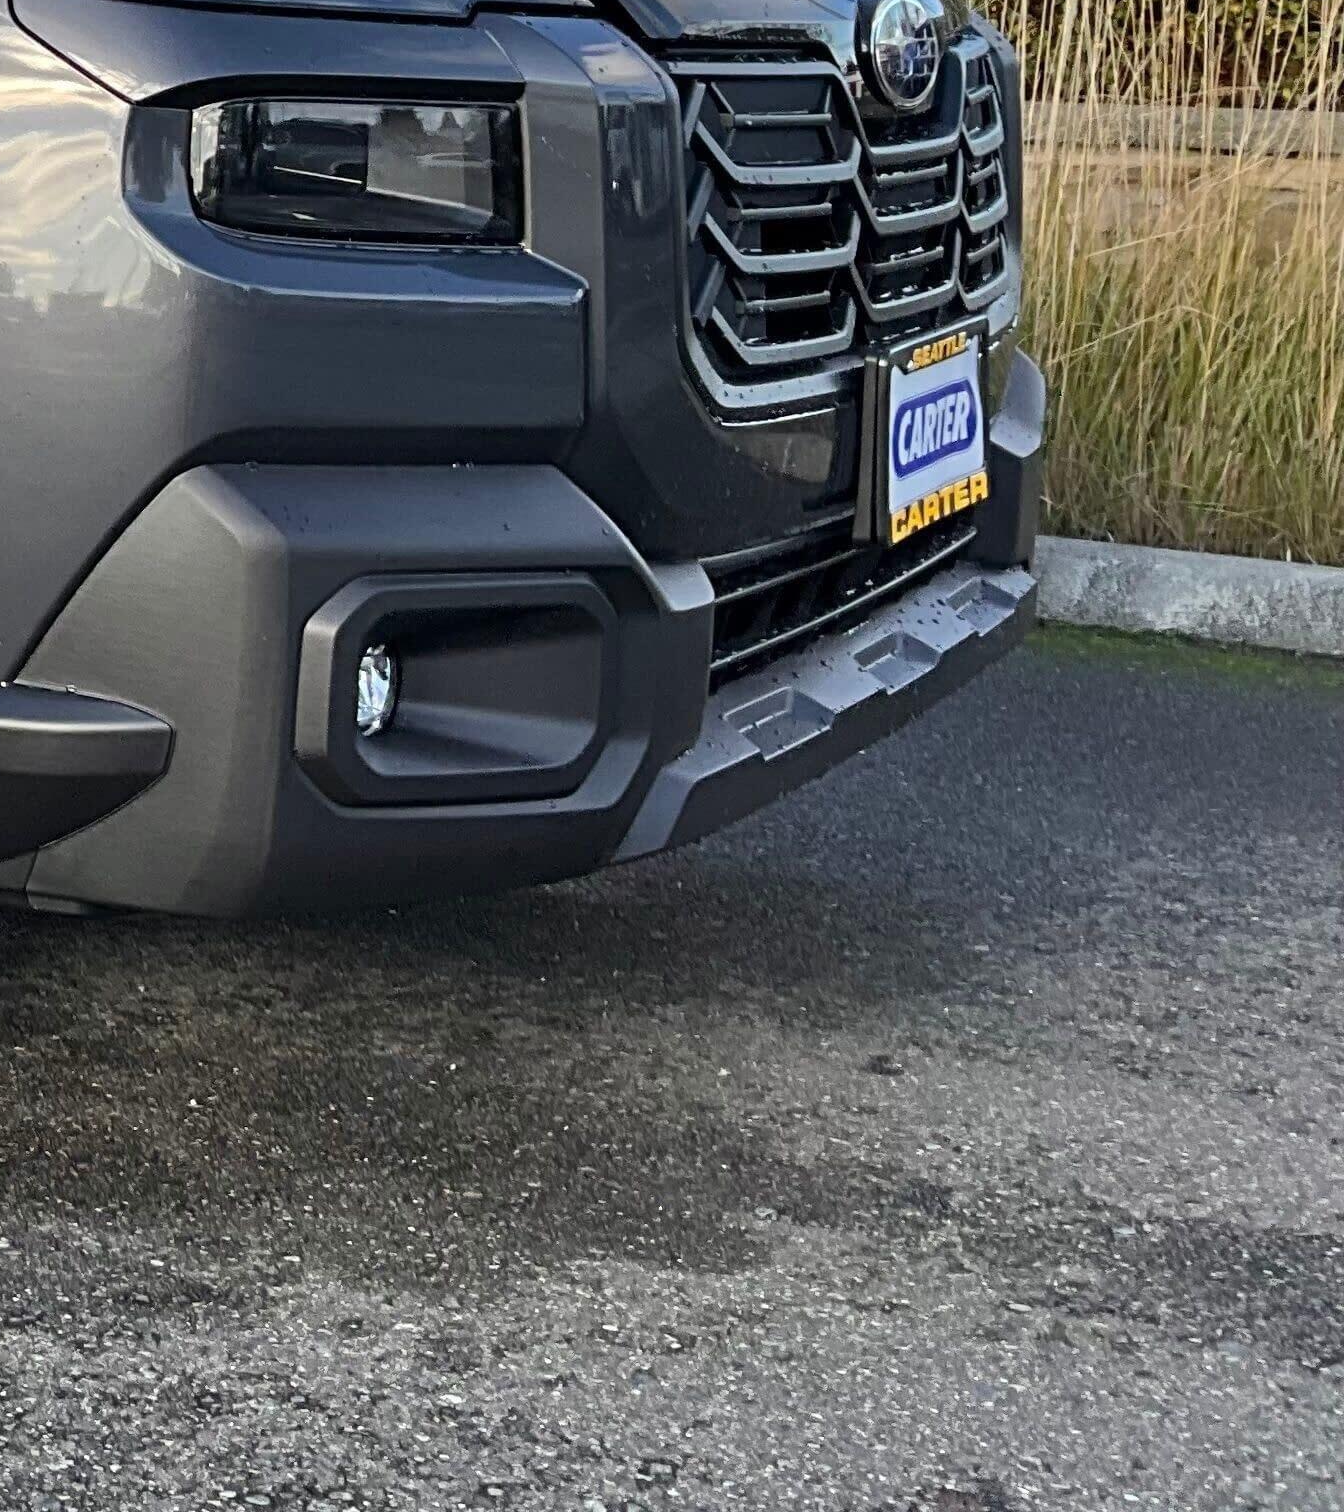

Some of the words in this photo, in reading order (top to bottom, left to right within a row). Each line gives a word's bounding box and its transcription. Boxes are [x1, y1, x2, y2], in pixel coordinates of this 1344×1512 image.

[912, 332, 967, 369] SEATTLE
[898, 390, 971, 466] CARTER
[891, 471, 989, 545] CARTER
